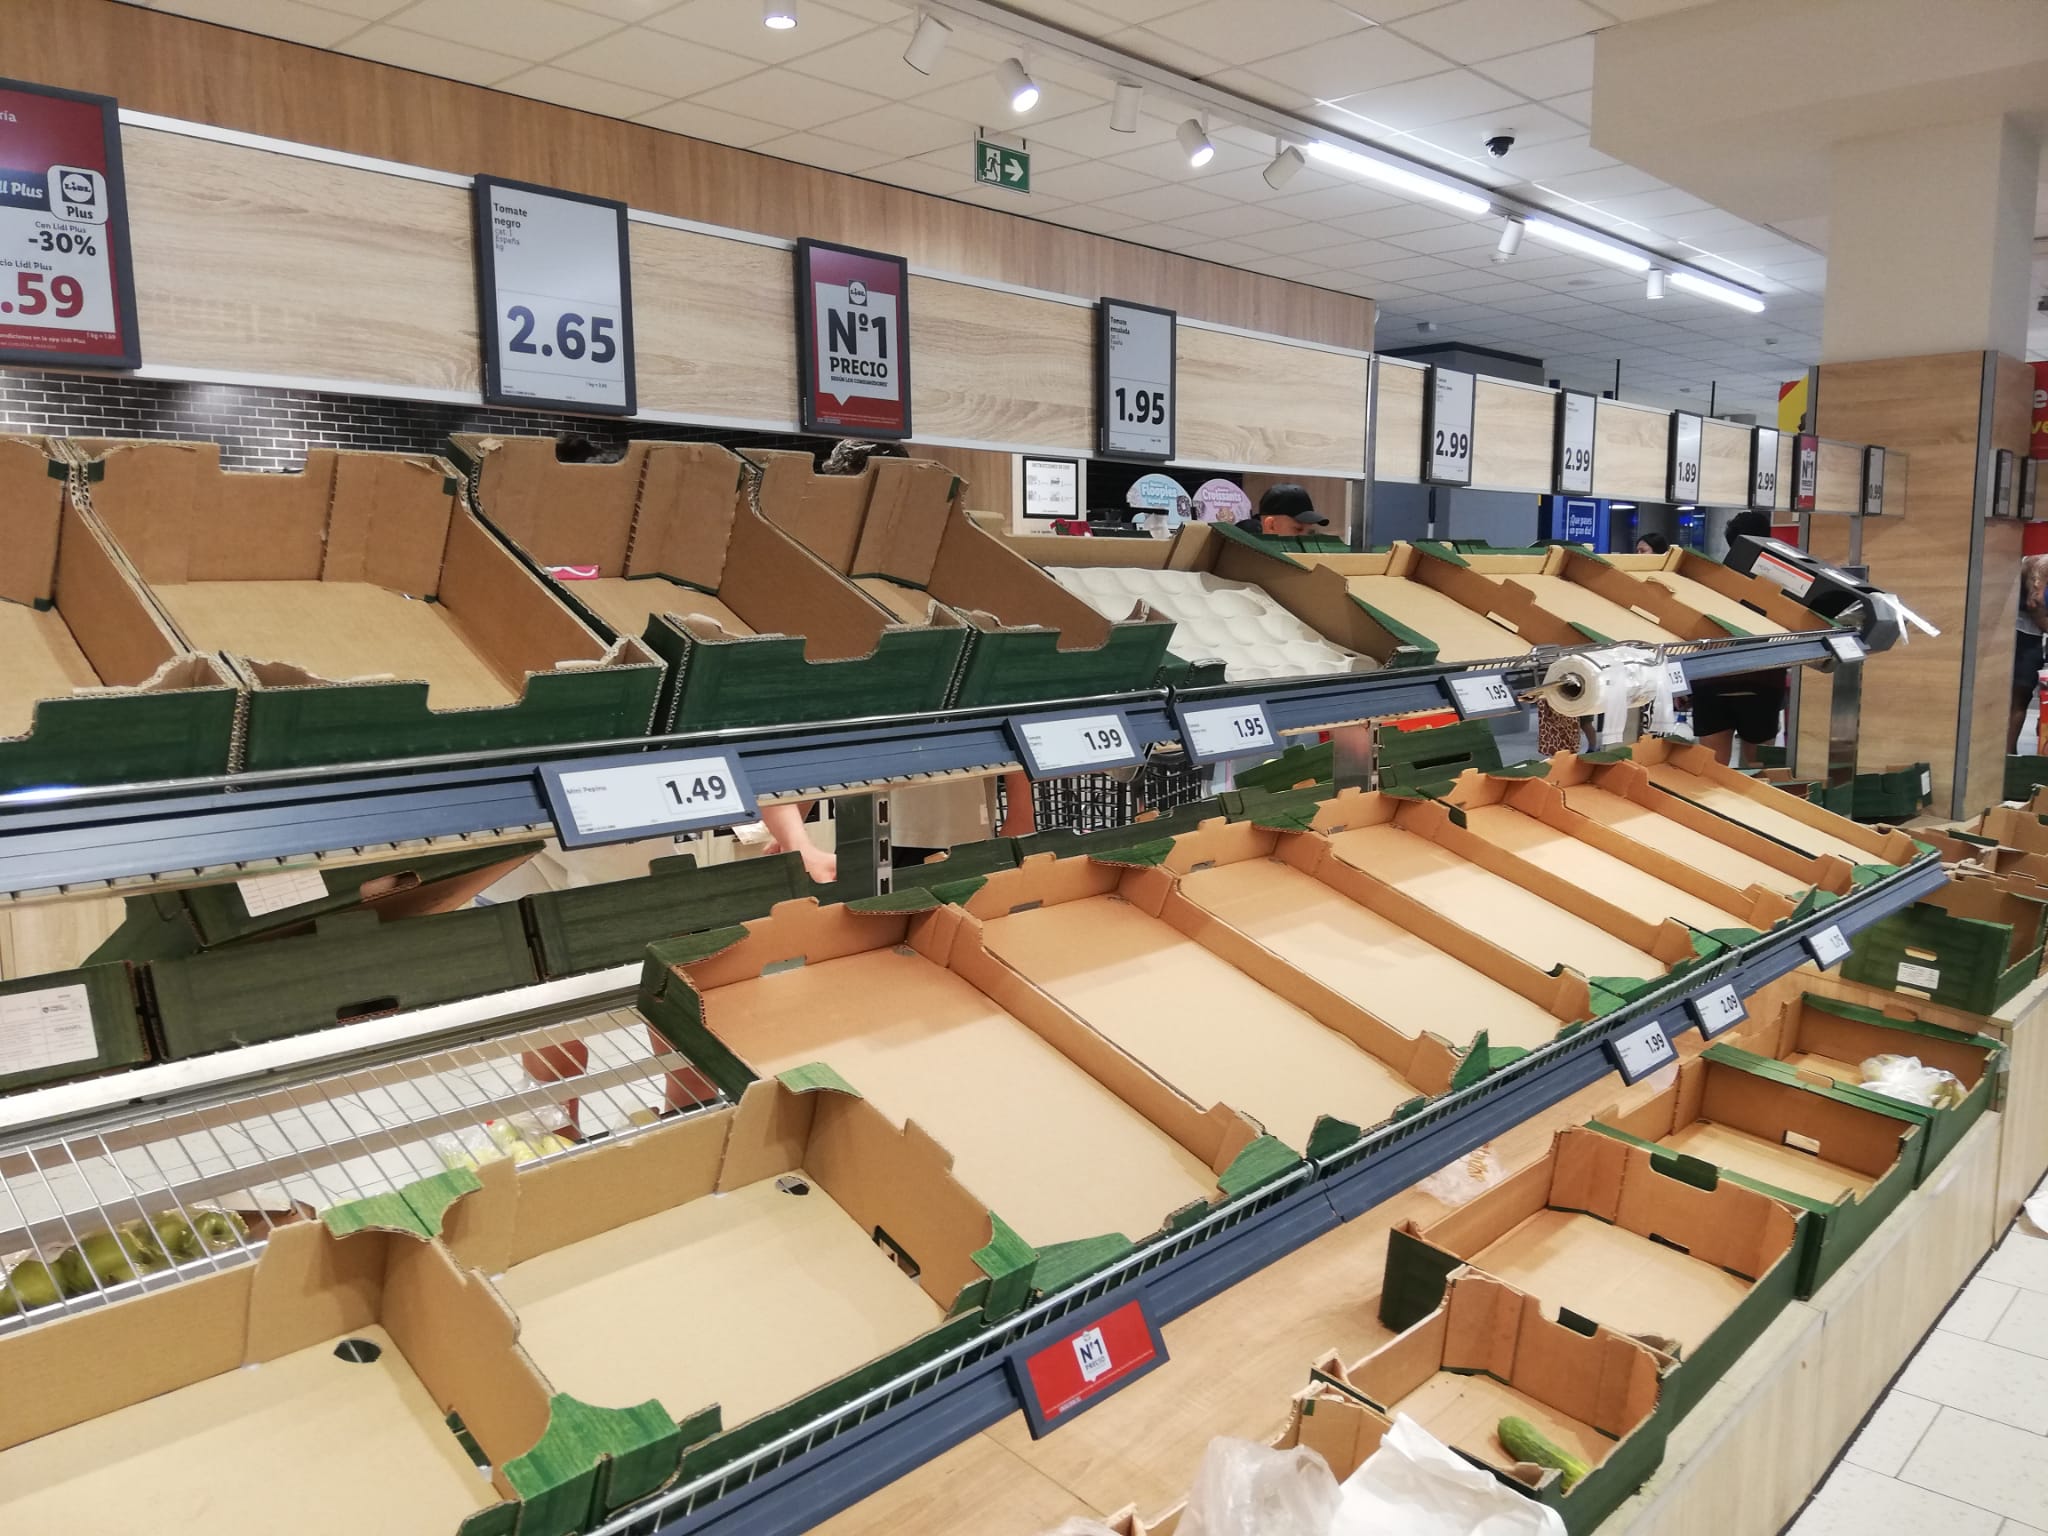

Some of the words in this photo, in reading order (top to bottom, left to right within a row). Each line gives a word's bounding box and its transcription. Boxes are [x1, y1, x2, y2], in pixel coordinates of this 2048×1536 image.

[11, 182, 43, 198] Plus
[66, 205, 93, 219] Plus
[493, 203, 528, 217] Tomate
[53, 223, 68, 232] Lidl
[69, 225, 86, 234] Plus
[494, 217, 521, 229] negro
[28, 230, 96, 256] -30%
[15, 260, 31, 269] Lidl
[33, 262, 53, 271] Plus
[507, 305, 616, 363] 2.65
[829, 356, 888, 379] PRECIO
[1115, 388, 1165, 425] 1.95
[1436, 430, 1468, 459] 2.99
[1565, 448, 1590, 472] 2.99
[1678, 461, 1697, 483] 1.89
[1757, 471, 1774, 492] 2.99
[1668, 670, 1683, 684] 1.95
[1485, 684, 1507, 701] 1.95
[1234, 717, 1264, 738] 1.95
[1084, 728, 1122, 751] 1.99
[665, 775, 726, 805] 1.49
[1720, 994, 1739, 1014] 2.09
[1645, 1033, 1665, 1054] 1.99
